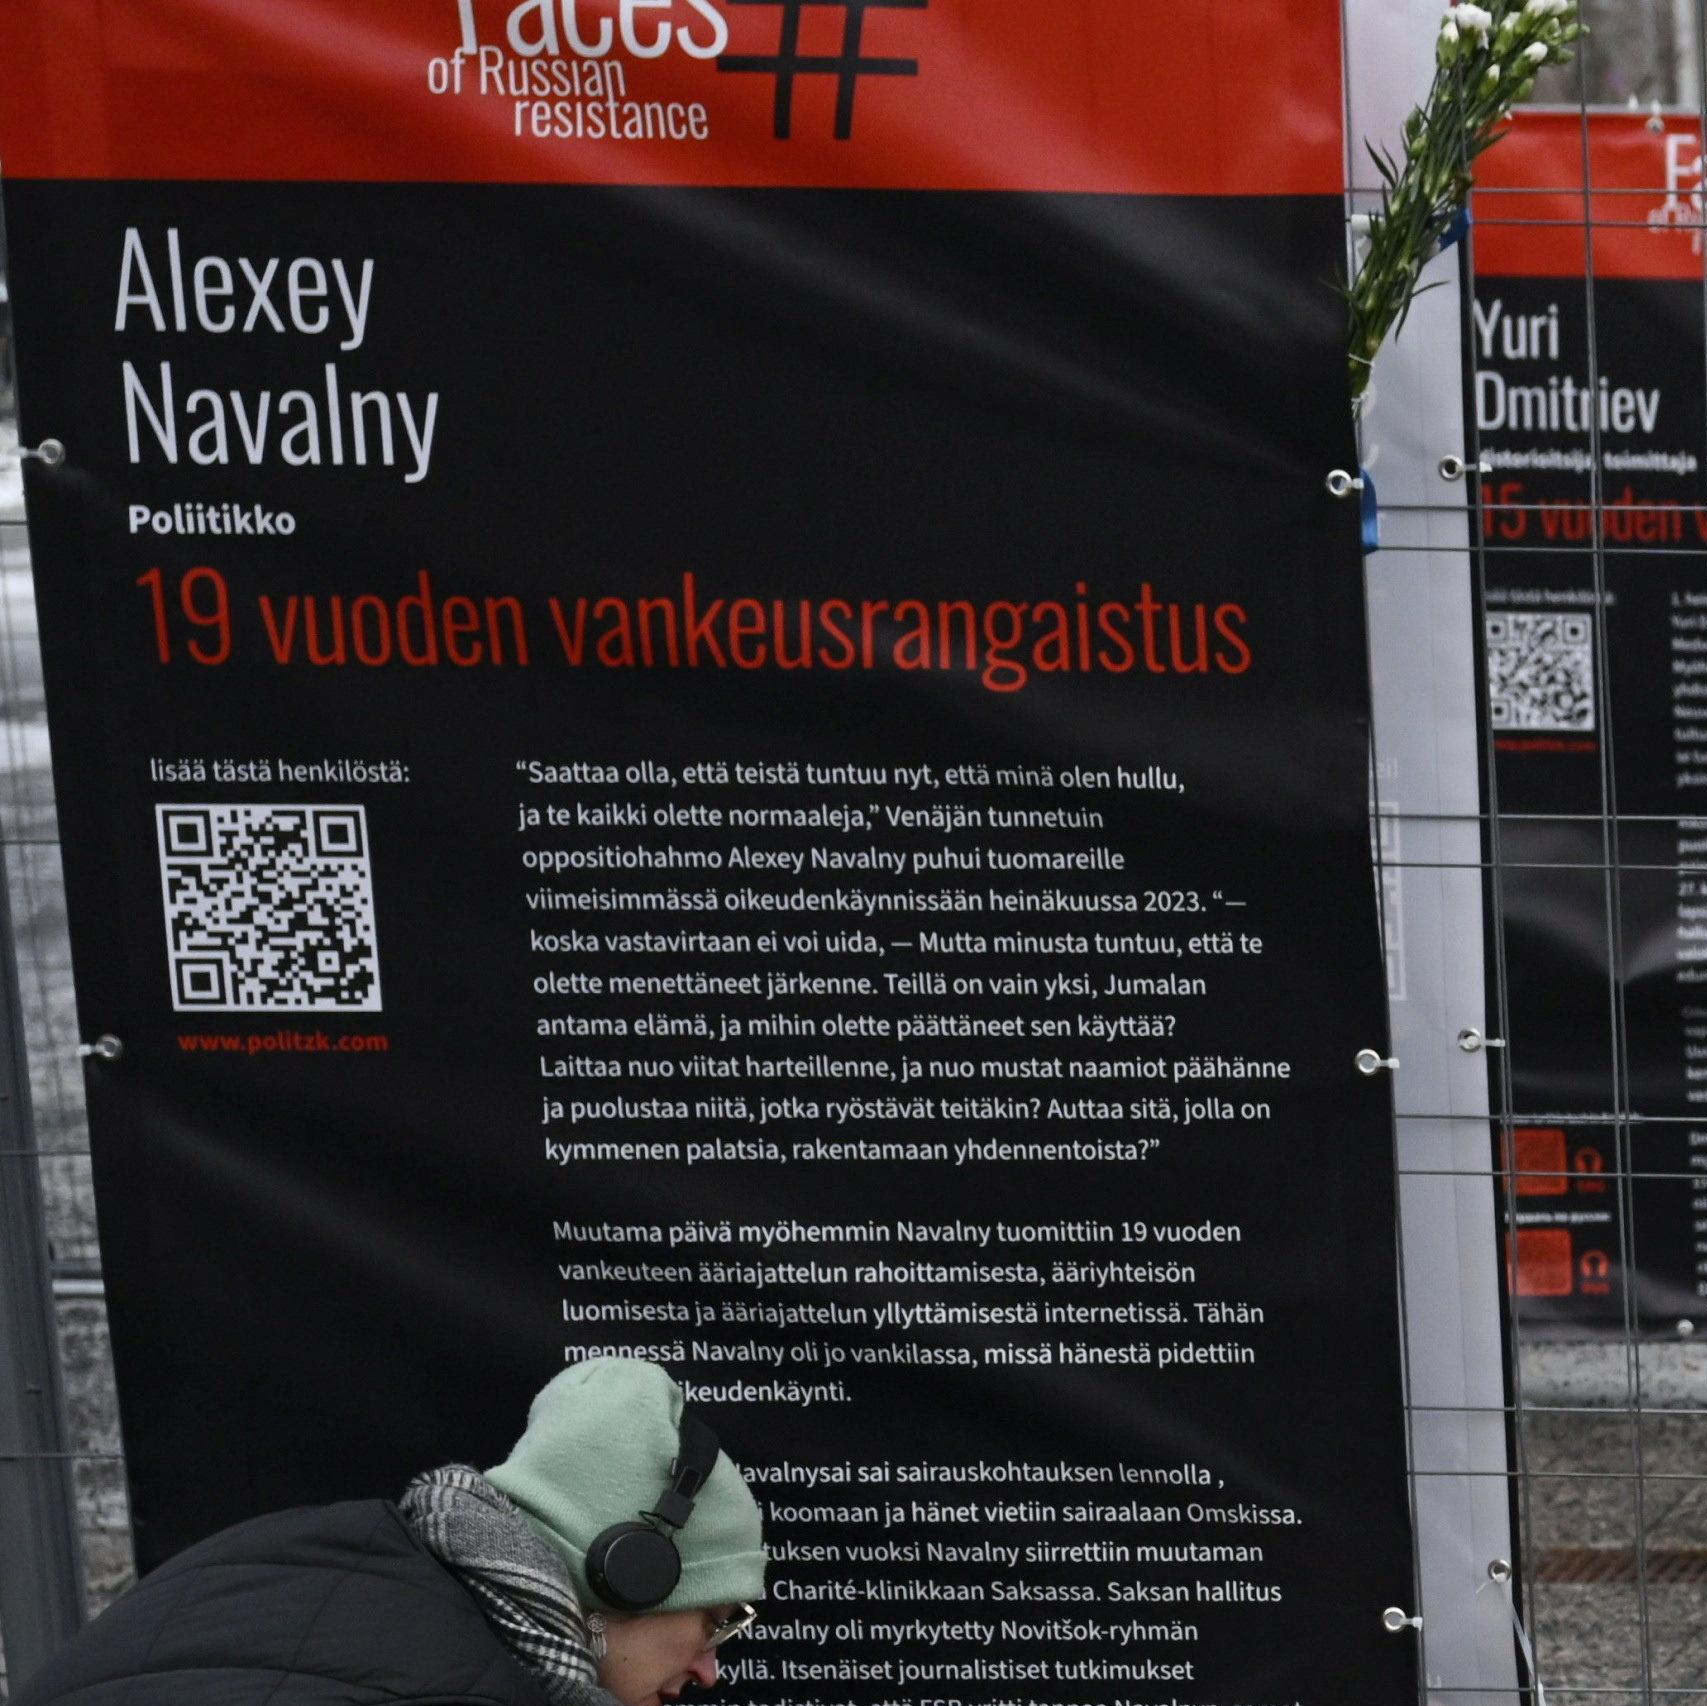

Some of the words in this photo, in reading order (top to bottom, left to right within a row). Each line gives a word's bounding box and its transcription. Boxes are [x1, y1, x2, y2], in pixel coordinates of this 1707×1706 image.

[427, 46, 465, 94] of
[480, 46, 627, 97] Russian
[514, 100, 709, 140] resistance
[114, 227, 375, 352] Alexey
[1474, 298, 1560, 360] Yuri
[1475, 370, 1661, 434] Dmitriev
[122, 361, 440, 484] Navalny
[128, 503, 297, 536] Poliitikko
[1481, 482, 1527, 541] 15
[1538, 487, 1684, 542] vuoden
[138, 567, 231, 665] 19
[259, 571, 528, 666] vuoden
[549, 572, 1251, 693] vankeusrangaistus
[149, 758, 207, 783] lisää
[212, 758, 272, 783] tästä
[278, 757, 411, 784] henkilöstä:
[625, 759, 678, 788] olla,
[682, 760, 730, 784] että
[734, 761, 801, 785] teistä
[805, 762, 888, 785] tuntuu
[893, 763, 940, 791] nyt,
[944, 763, 990, 786] että
[995, 764, 1054, 787] minä
[1059, 765, 1111, 789] olen
[1117, 765, 1185, 794] hullu,
[517, 802, 541, 832] ja
[546, 804, 571, 827] te
[576, 802, 648, 826] kaikki
[653, 802, 723, 827] olette
[884, 804, 982, 833] Venäjän
[986, 806, 1104, 829] tunnetuin
[522, 844, 723, 874] oppositiohahmo
[727, 845, 805, 875] Alexey
[810, 845, 907, 875] Navalny
[912, 846, 982, 875] puhui
[986, 846, 1125, 870] tuomareille
[525, 887, 719, 911] viimeisimmässä
[724, 887, 983, 917] oikeudenkäynnissään
[989, 888, 1138, 912] heinäkuussa
[1143, 890, 1207, 913] 2023.
[533, 970, 604, 995] olette
[608, 971, 763, 995] menettäneet
[766, 971, 879, 1001] järkenne.
[882, 971, 947, 995] Teillä
[952, 977, 984, 995] on
[988, 972, 1039, 996] vain
[1043, 972, 1098, 1001] yksi,
[1103, 972, 1207, 996] Jumalan
[177, 1030, 390, 1055] www.politzk.com
[540, 1054, 622, 1078] Laittaa
[628, 1059, 675, 1078] nuo
[678, 1054, 741, 1078] viitat
[745, 1054, 897, 1082] harteillenne,
[900, 1055, 923, 1084] ja
[929, 1060, 976, 1078] nuo
[980, 1057, 1064, 1079] mustat
[1069, 1055, 1168, 1079] naamiot
[1173, 1055, 1291, 1084] päähänne
[545, 1136, 680, 1166] kymmenen
[686, 1137, 787, 1166] palatsia,
[792, 1137, 949, 1161] rakentamaan
[552, 1220, 663, 1243] Muutama
[669, 1220, 732, 1248] päivä
[738, 1219, 891, 1248] myöhemmin
[896, 1219, 992, 1248] Navalny
[995, 1220, 1114, 1243] tuomittiin
[1121, 1221, 1148, 1243] 19
[1152, 1219, 1242, 1243] vuoden
[562, 1298, 690, 1322] luomisesta
[694, 1300, 716, 1327] ja
[721, 1301, 868, 1329] ääriajattelun
[872, 1301, 1039, 1330] yllyttämisestä
[1044, 1301, 1189, 1324] internetissä.
[1193, 1301, 1265, 1324] Tähän
[681, 1380, 853, 1407] ikeudenkäynti.
[857, 1460, 890, 1483] sai
[896, 1460, 1114, 1483] sairauskohtauksen
[1118, 1462, 1212, 1486] lennolla
[772, 1578, 985, 1601] Charité-klinikkaan
[990, 1579, 1102, 1602] Saksassa.
[1107, 1580, 1190, 1603] Saksan
[1195, 1580, 1283, 1603] hallitus
